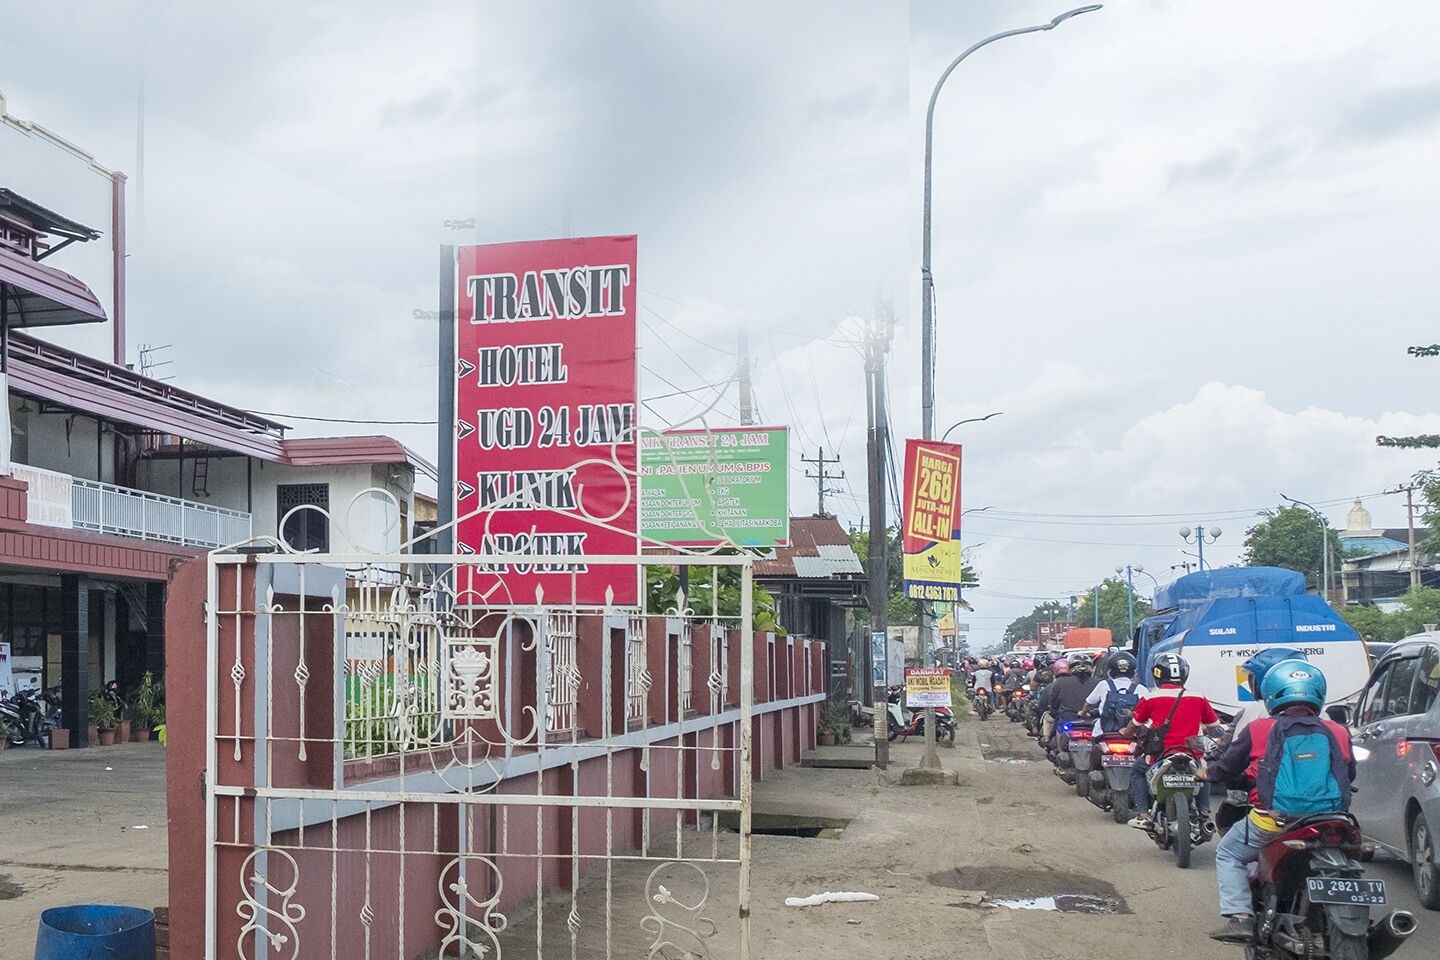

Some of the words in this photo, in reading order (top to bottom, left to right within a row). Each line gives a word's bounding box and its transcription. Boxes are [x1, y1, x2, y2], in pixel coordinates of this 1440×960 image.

[468, 264, 629, 324] TRANSIT
[478, 343, 567, 387] HOTEL
[478, 408, 534, 450] UGD
[538, 406, 572, 448] 24
[575, 403, 636, 447] JAM
[666, 434, 719, 448] TRANST
[721, 433, 738, 446] 24
[740, 432, 770, 446] JAM
[736, 462, 746, 473] &
[746, 461, 771, 473] BPJS
[922, 455, 953, 474] HARGA
[477, 468, 576, 511] KLINIK
[918, 467, 952, 503] 268
[916, 499, 951, 516] JUTA-AN
[914, 511, 950, 539] ALL-IN
[477, 533, 588, 575] APOTEK
[909, 584, 925, 599] 0812
[1209, 627, 1236, 636] SOLAR
[1295, 624, 1337, 633] INDUSTRI
[1309, 879, 1325, 890] DD
[1330, 880, 1360, 892] 2821
[1368, 882, 1383, 893] TV
